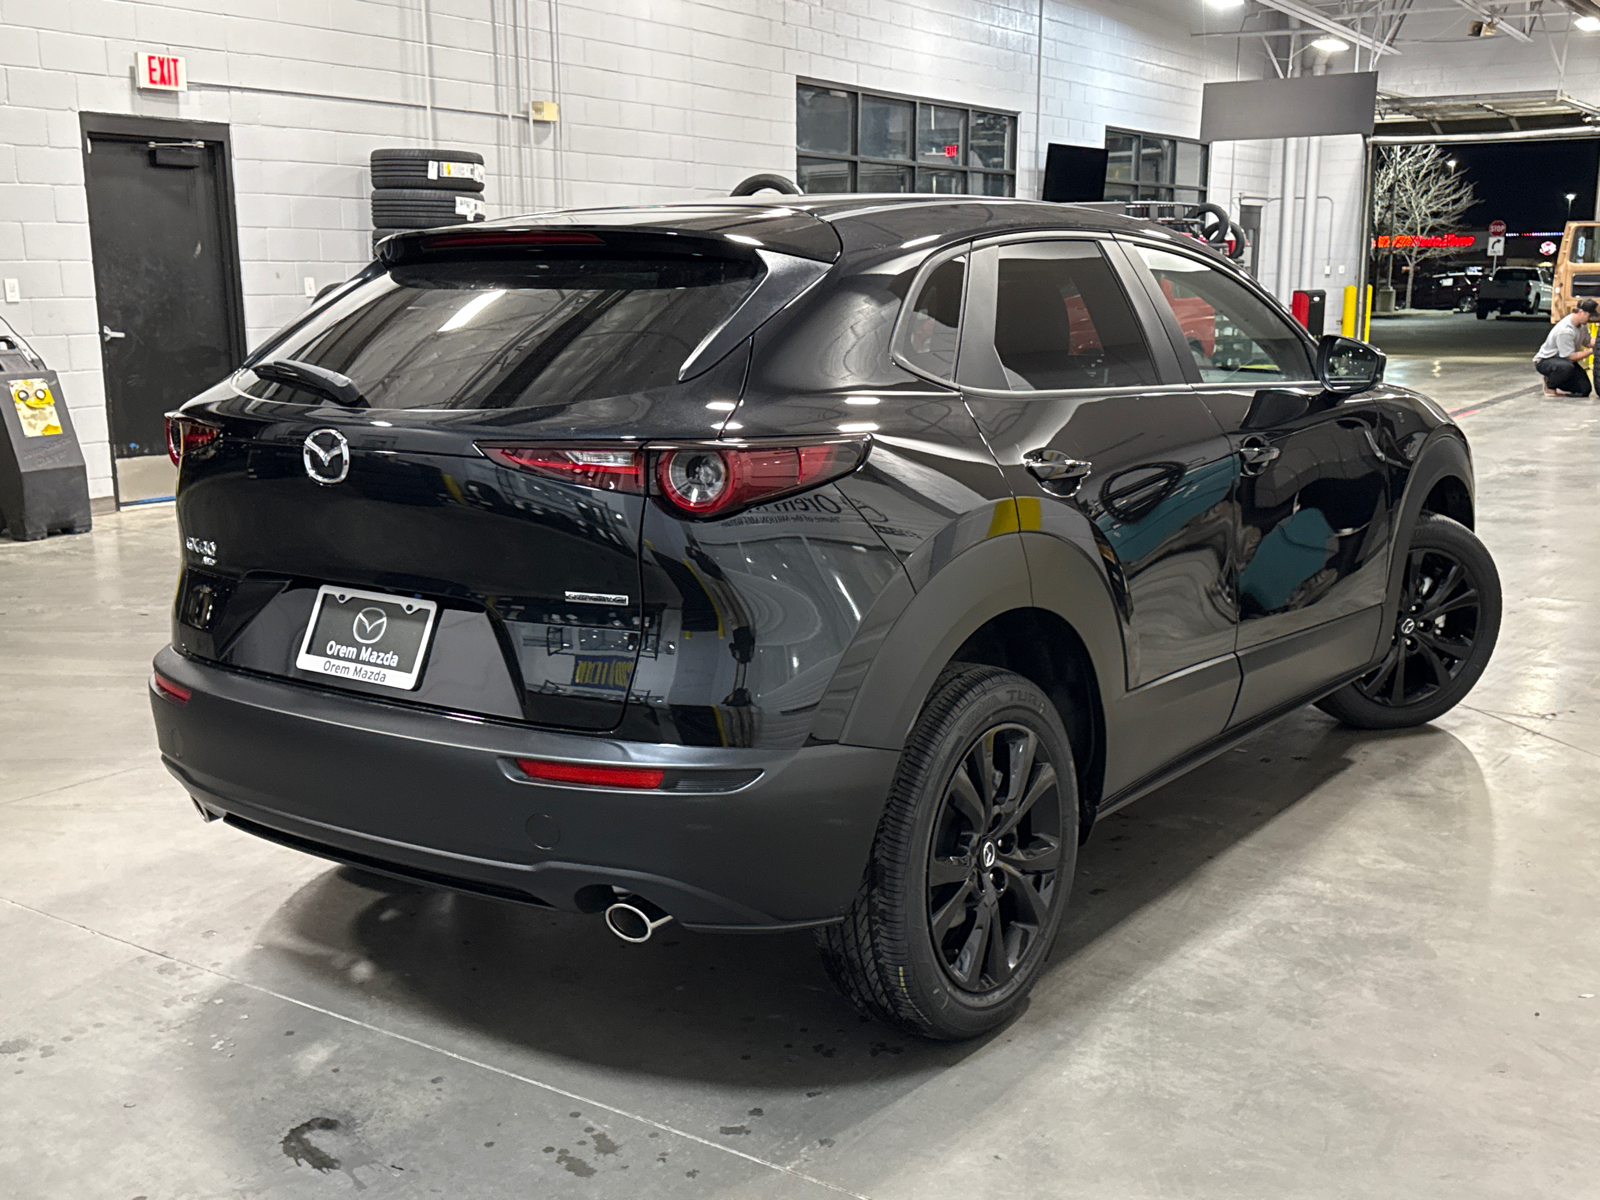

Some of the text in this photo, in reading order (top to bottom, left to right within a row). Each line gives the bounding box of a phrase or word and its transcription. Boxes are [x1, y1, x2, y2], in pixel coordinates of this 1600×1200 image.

[147, 55, 179, 87] EXIT
[1490, 224, 1505, 232] STOP
[326, 640, 399, 667] Orem Mazda
[323, 660, 387, 682] Orem Mazda
